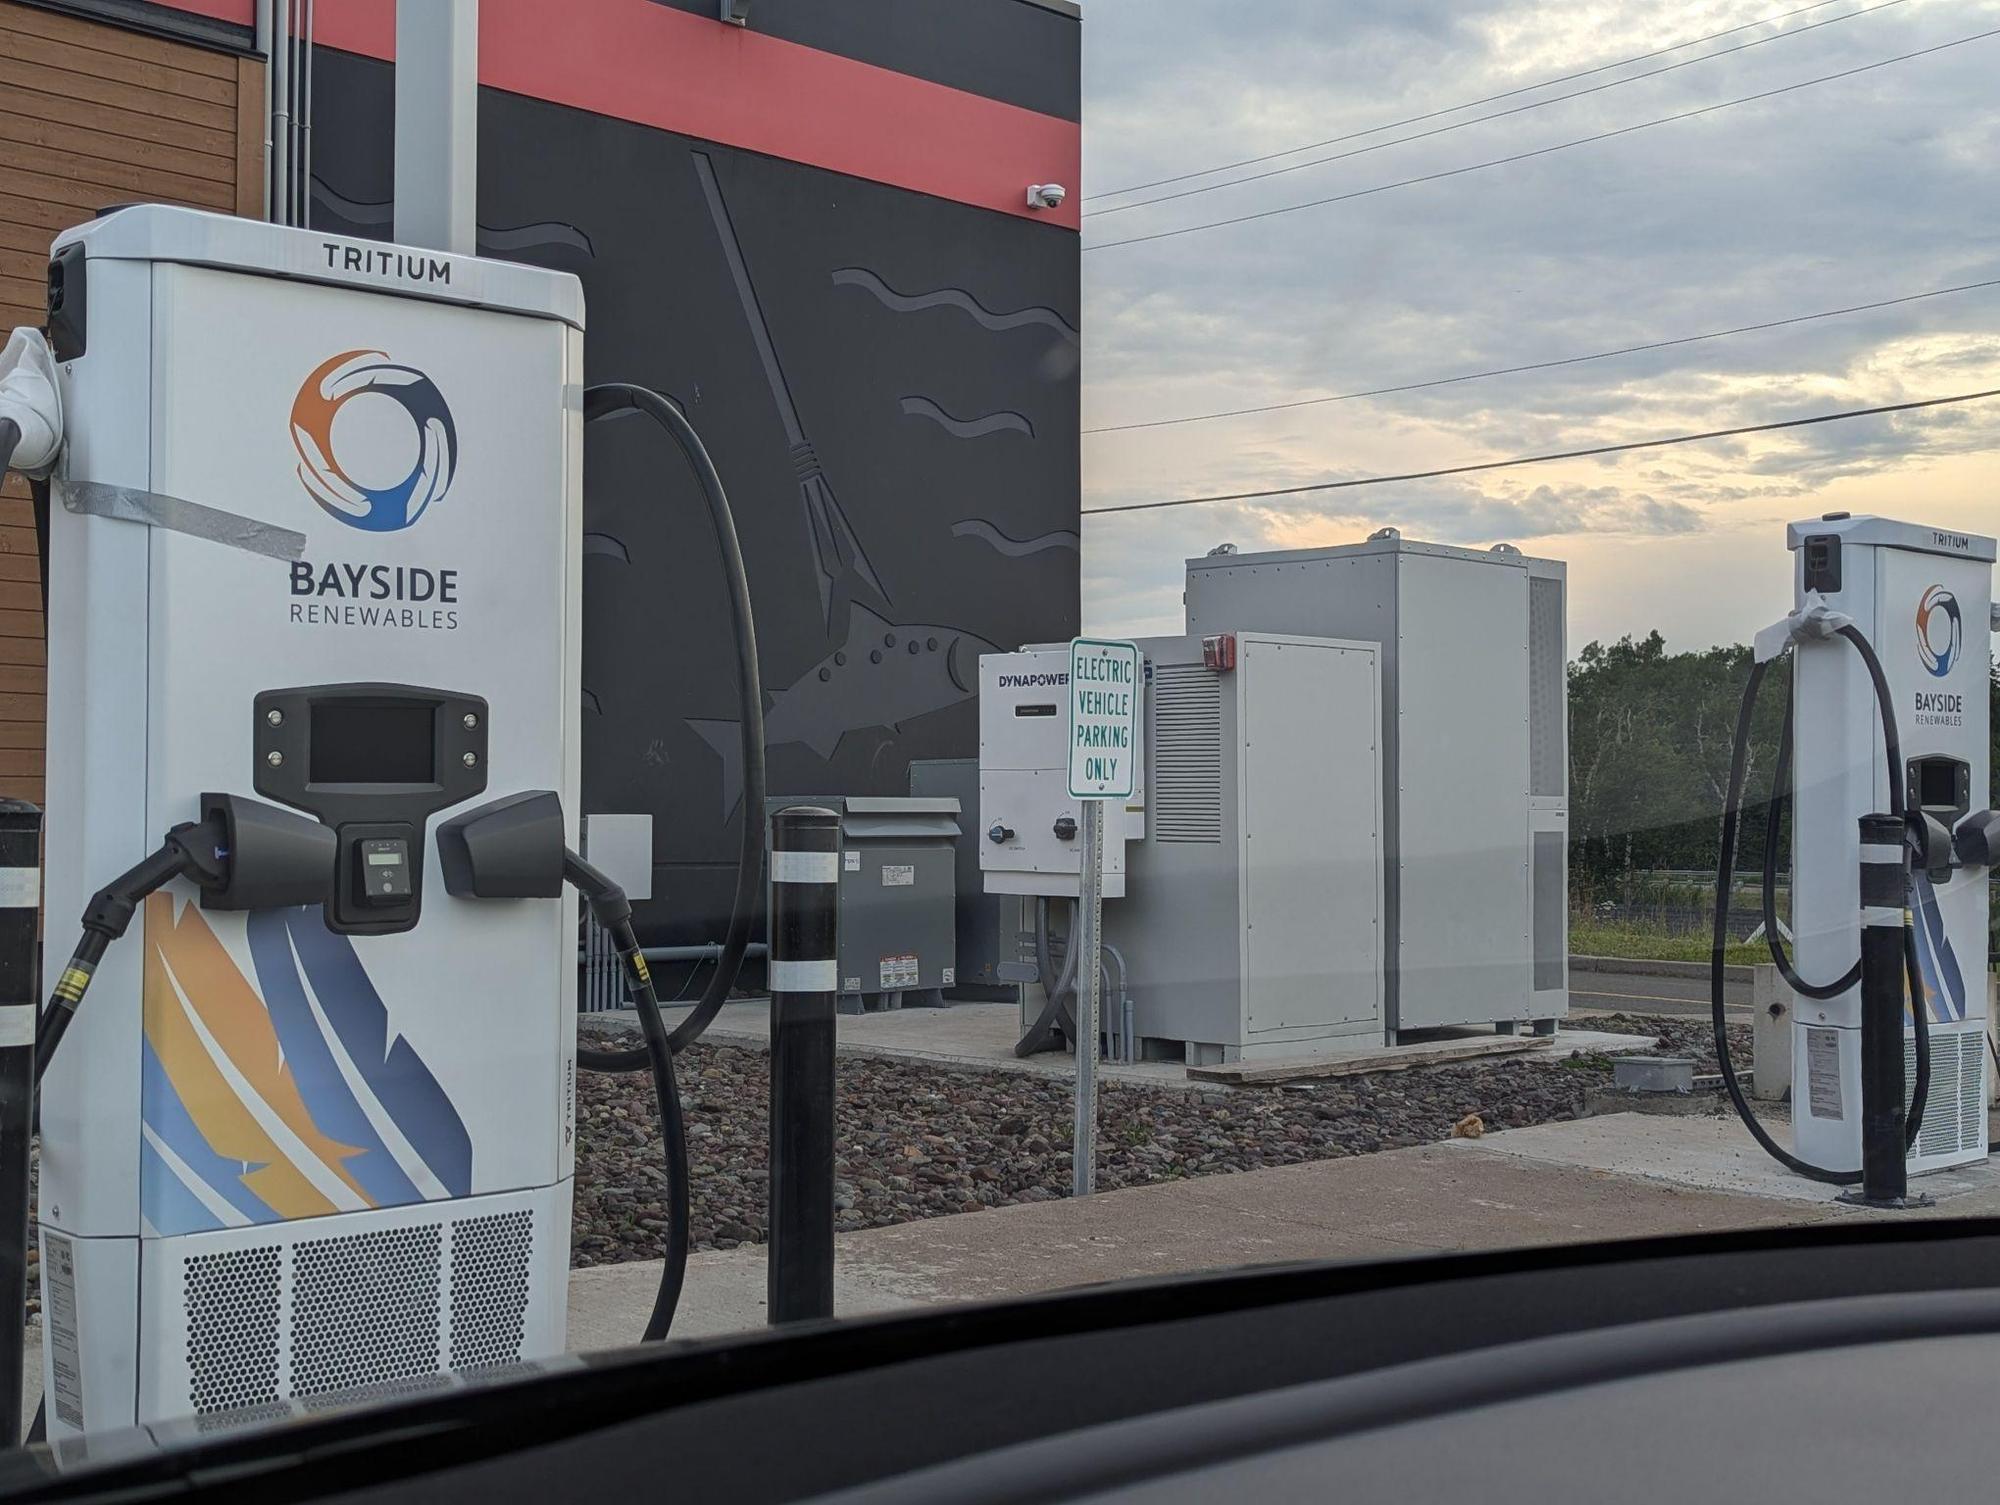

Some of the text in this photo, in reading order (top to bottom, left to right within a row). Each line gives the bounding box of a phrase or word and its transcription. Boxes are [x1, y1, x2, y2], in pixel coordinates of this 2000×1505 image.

[323, 243, 450, 284] TRITIUM
[1933, 532, 1969, 550] TRITIUM
[289, 561, 457, 603] BAYSIDE
[290, 604, 458, 629] RENEWABLES
[1077, 657, 1131, 683] ELECTRIC
[1079, 691, 1128, 716] VEHICLE
[1915, 692, 1962, 713] BAYSIDE
[1915, 715, 1962, 727] RENEWABLES
[1077, 725, 1128, 748] PARKING
[1085, 757, 1117, 780] ONLY
